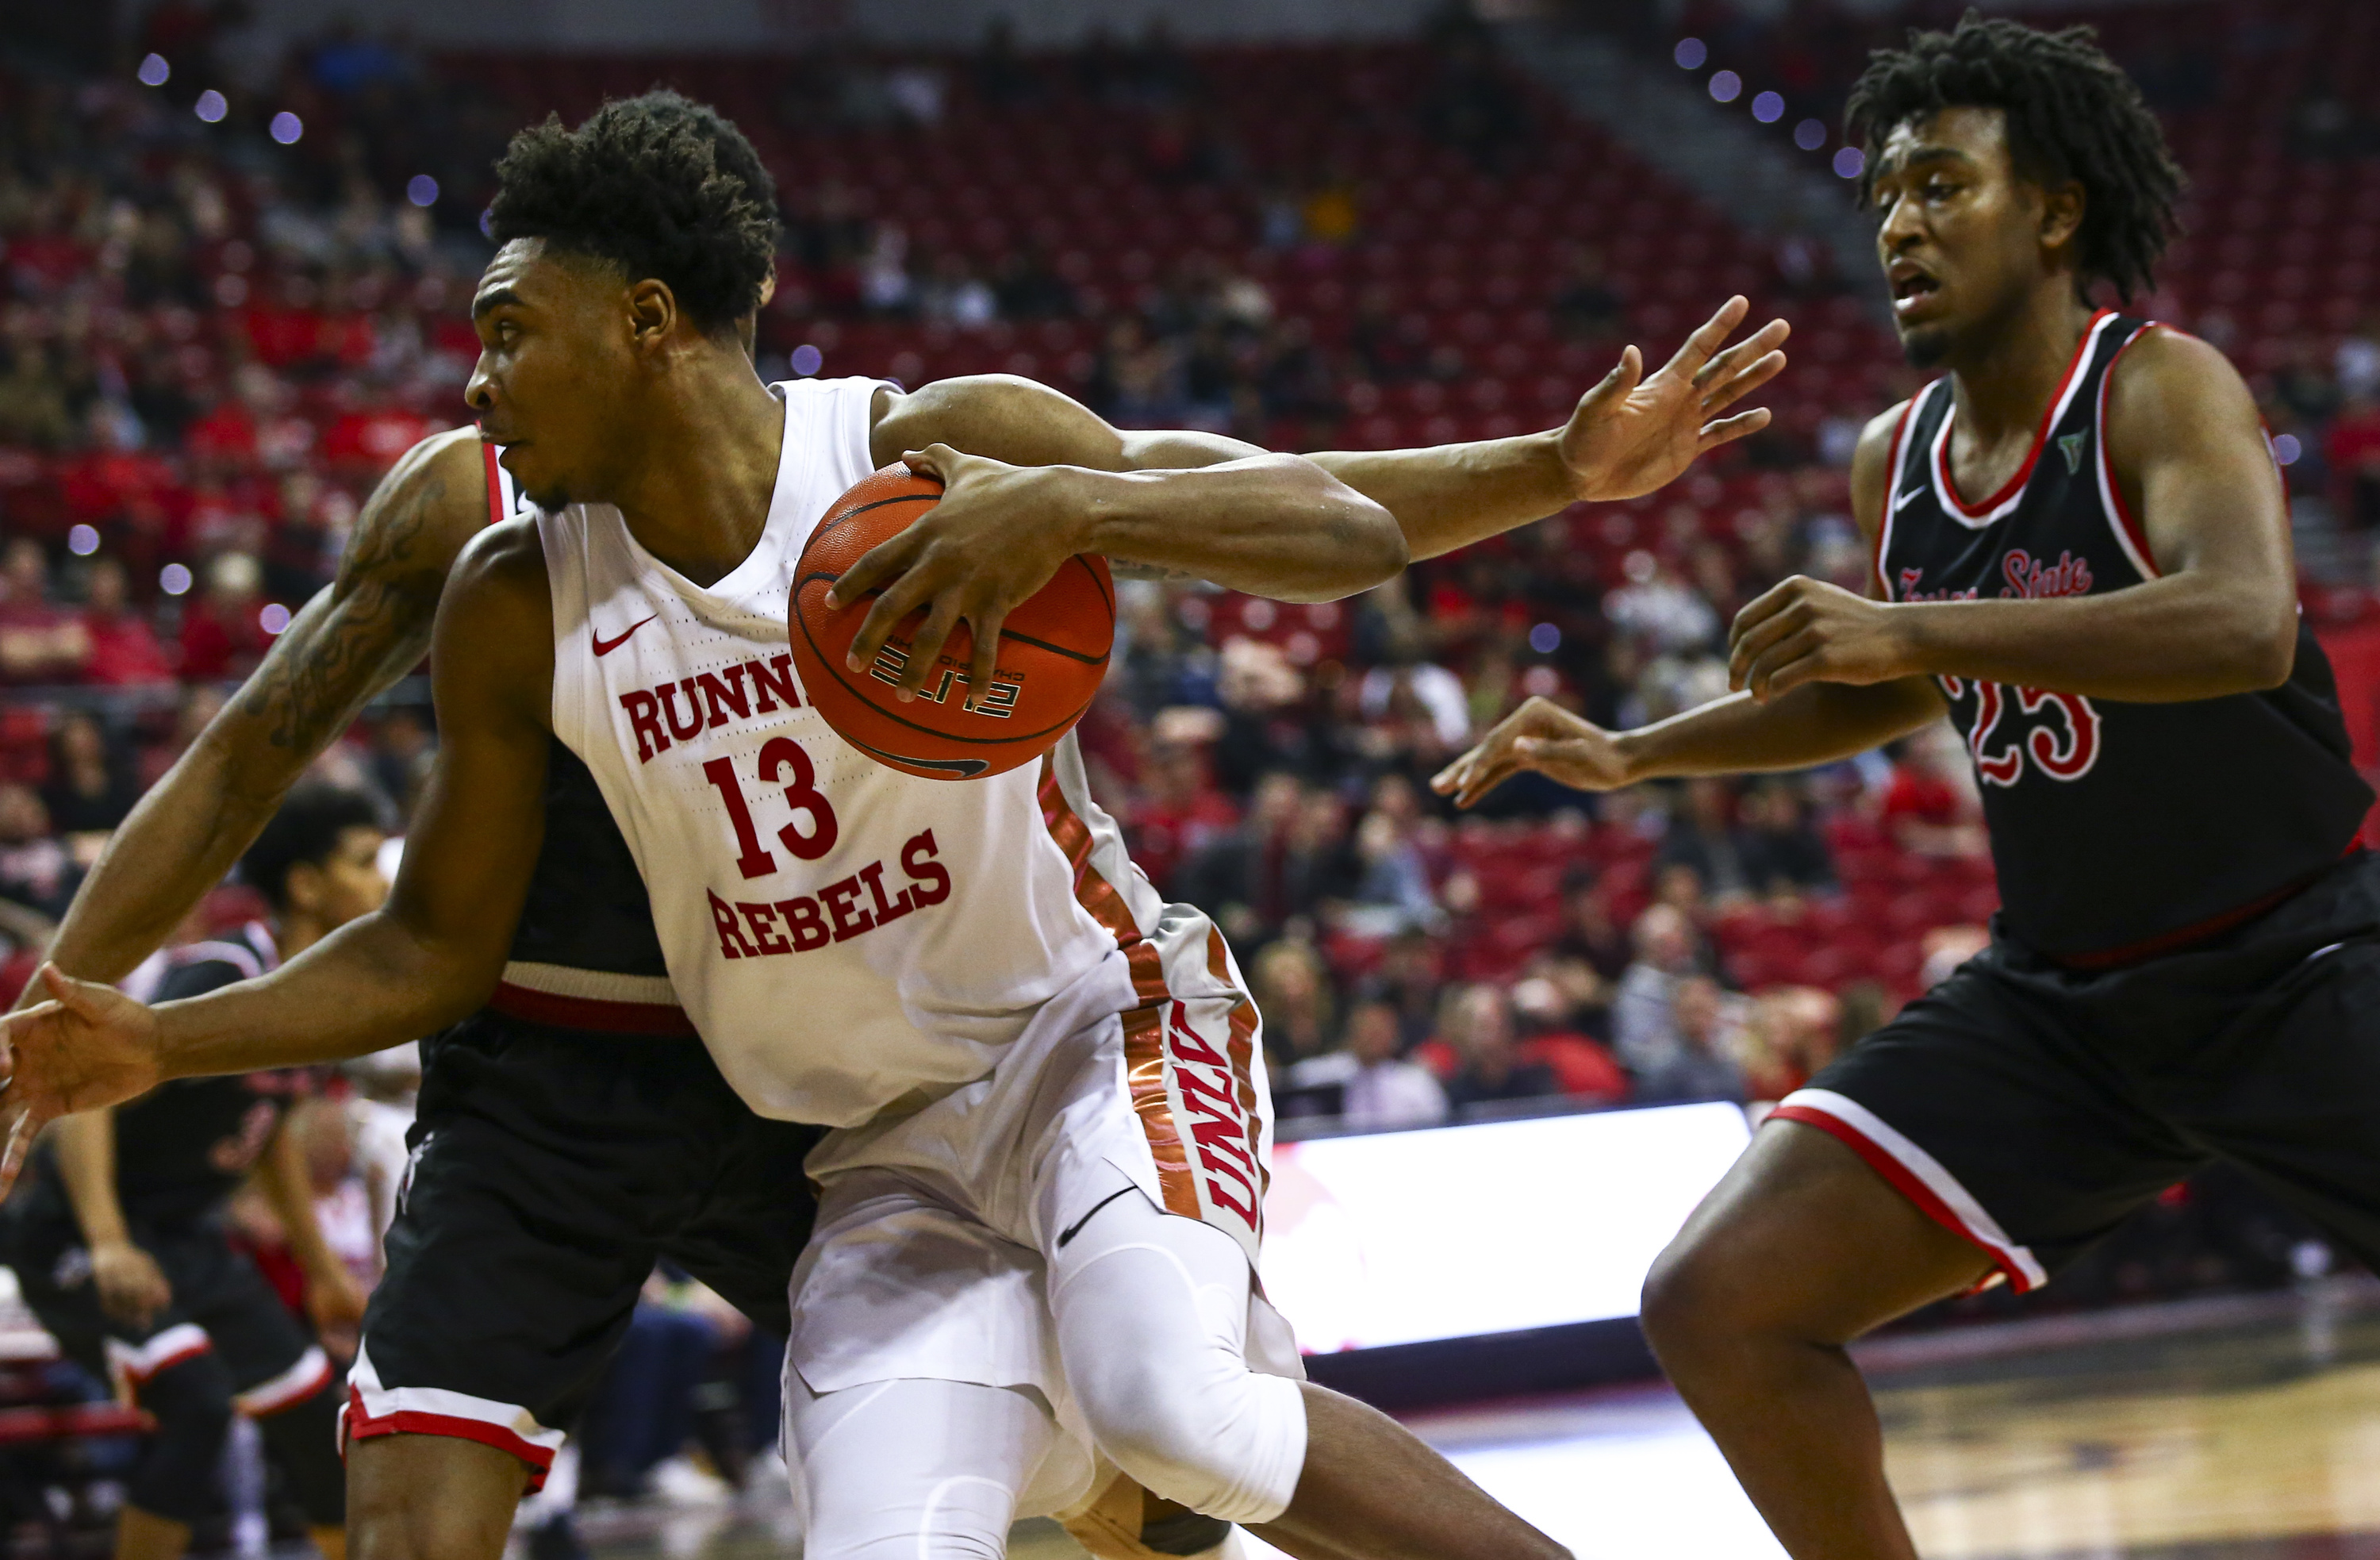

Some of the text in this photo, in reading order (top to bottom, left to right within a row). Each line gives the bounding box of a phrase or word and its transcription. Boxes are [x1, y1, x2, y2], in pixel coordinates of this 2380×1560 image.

[2000, 548, 2094, 599] State
[620, 653, 815, 764] RUNN
[1937, 674, 2102, 788] 25
[702, 736, 838, 879] 13
[707, 828, 951, 959] REBELS
[1169, 999, 1257, 1232] UNLV
